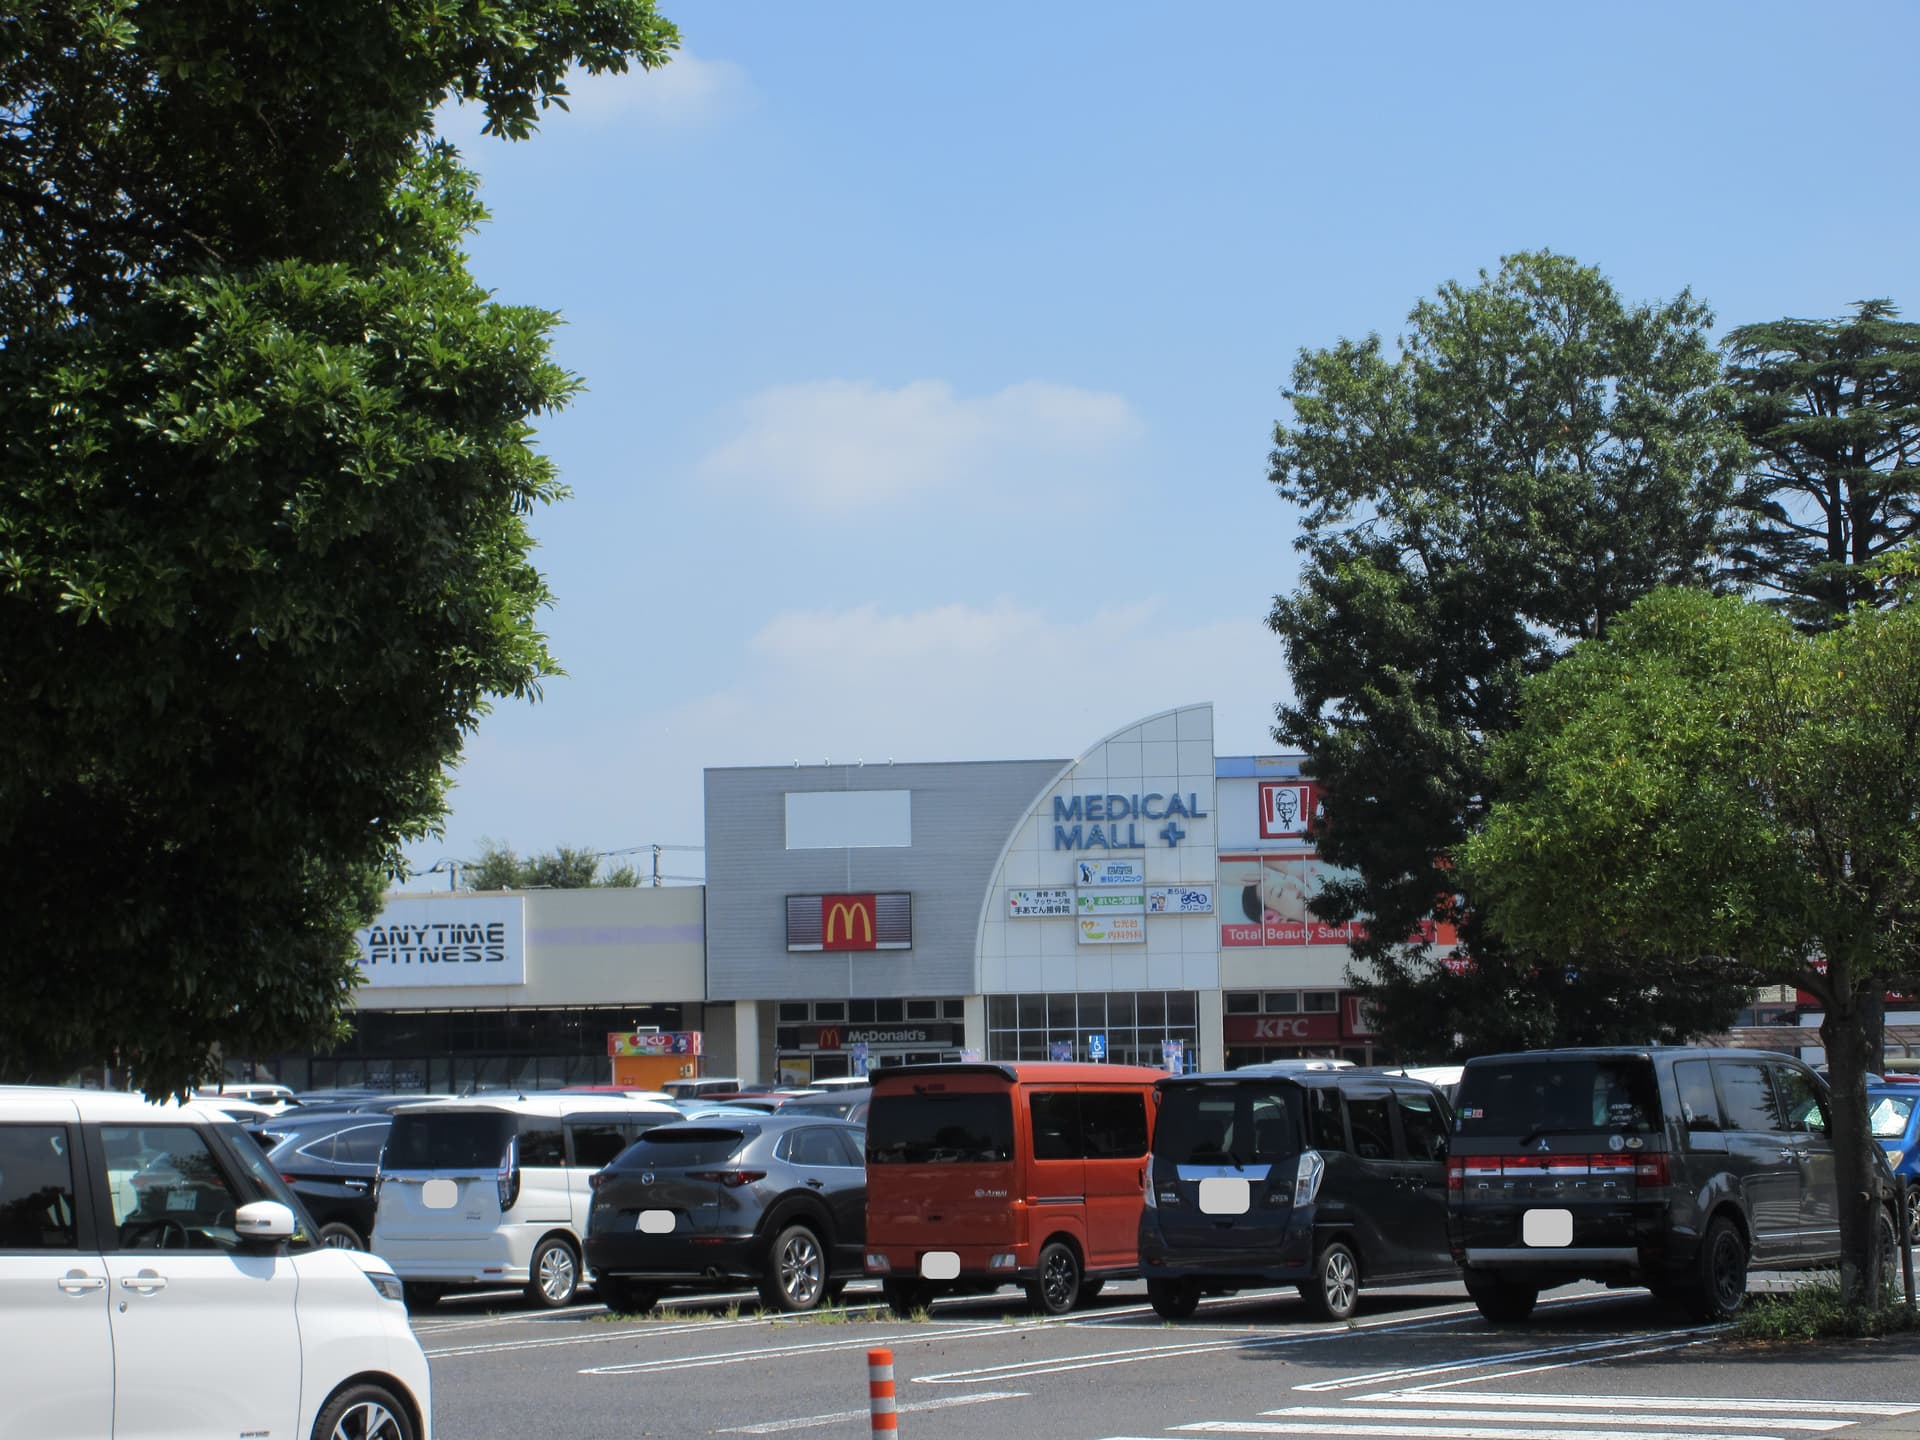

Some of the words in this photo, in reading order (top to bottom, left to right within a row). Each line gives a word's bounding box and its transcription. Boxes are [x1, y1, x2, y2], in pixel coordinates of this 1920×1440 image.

[1054, 793, 1207, 821] MEDICAL
[1054, 823, 1145, 850] MALL
[1181, 891, 1207, 904] こども
[368, 923, 504, 946] ANYTIME
[1228, 928, 1261, 940] Total
[1267, 928, 1314, 941] Beauty
[1318, 927, 1354, 938] Salon
[371, 946, 504, 964] FITNESS
[848, 1030, 926, 1041] McDonald's
[1254, 1019, 1309, 1038] KFC
